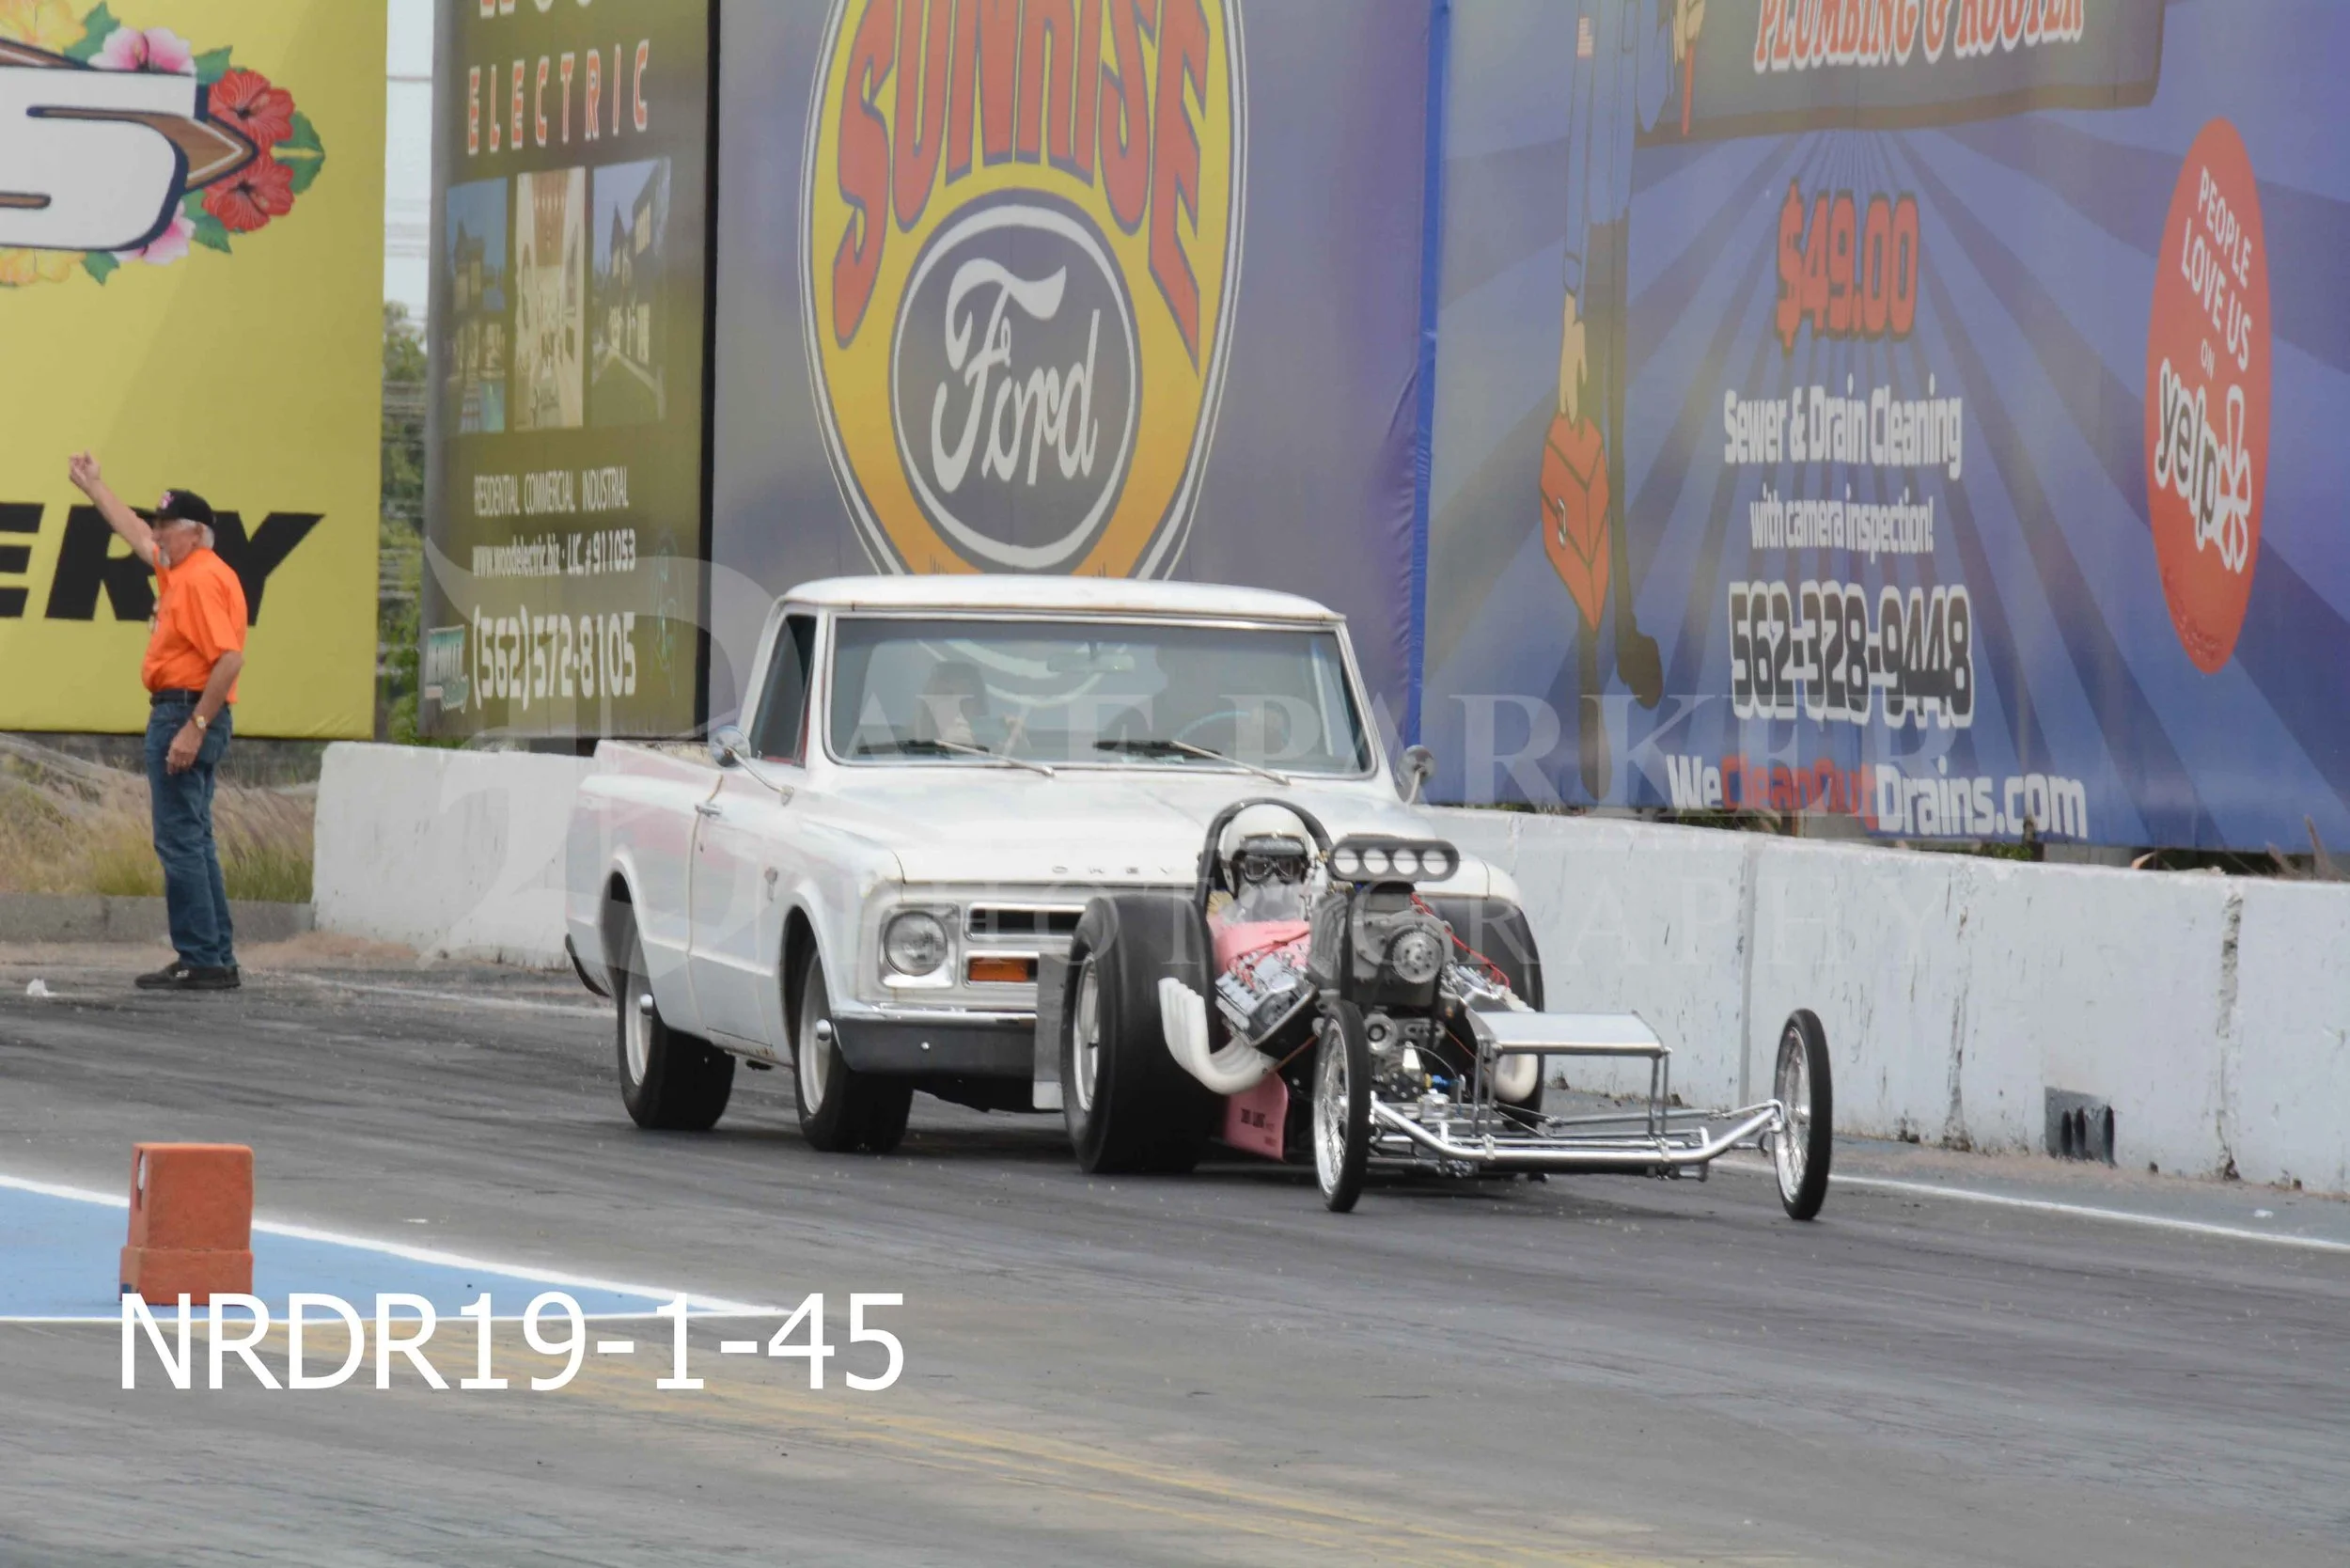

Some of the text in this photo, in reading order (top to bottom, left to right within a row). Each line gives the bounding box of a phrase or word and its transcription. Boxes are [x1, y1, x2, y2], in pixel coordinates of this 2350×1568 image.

[467, 39, 650, 155] ELECTRIC
[1776, 178, 1919, 358] $49.00
[2198, 165, 2252, 289] PEOPLE
[2181, 217, 2252, 372] LOVE US
[931, 258, 1100, 493] Ford
[2201, 338, 2216, 380] ON
[1724, 373, 1962, 480] Sewer & Drain Cleaning
[524, 469, 575, 515] COMMERCIAL
[582, 466, 629, 512] INDUSTRIAL
[1749, 482, 1934, 564] with camera inspection!
[1729, 579, 1973, 729] 562-328-9448
[1666, 755, 2088, 839] WeCleanOutDrains.com
